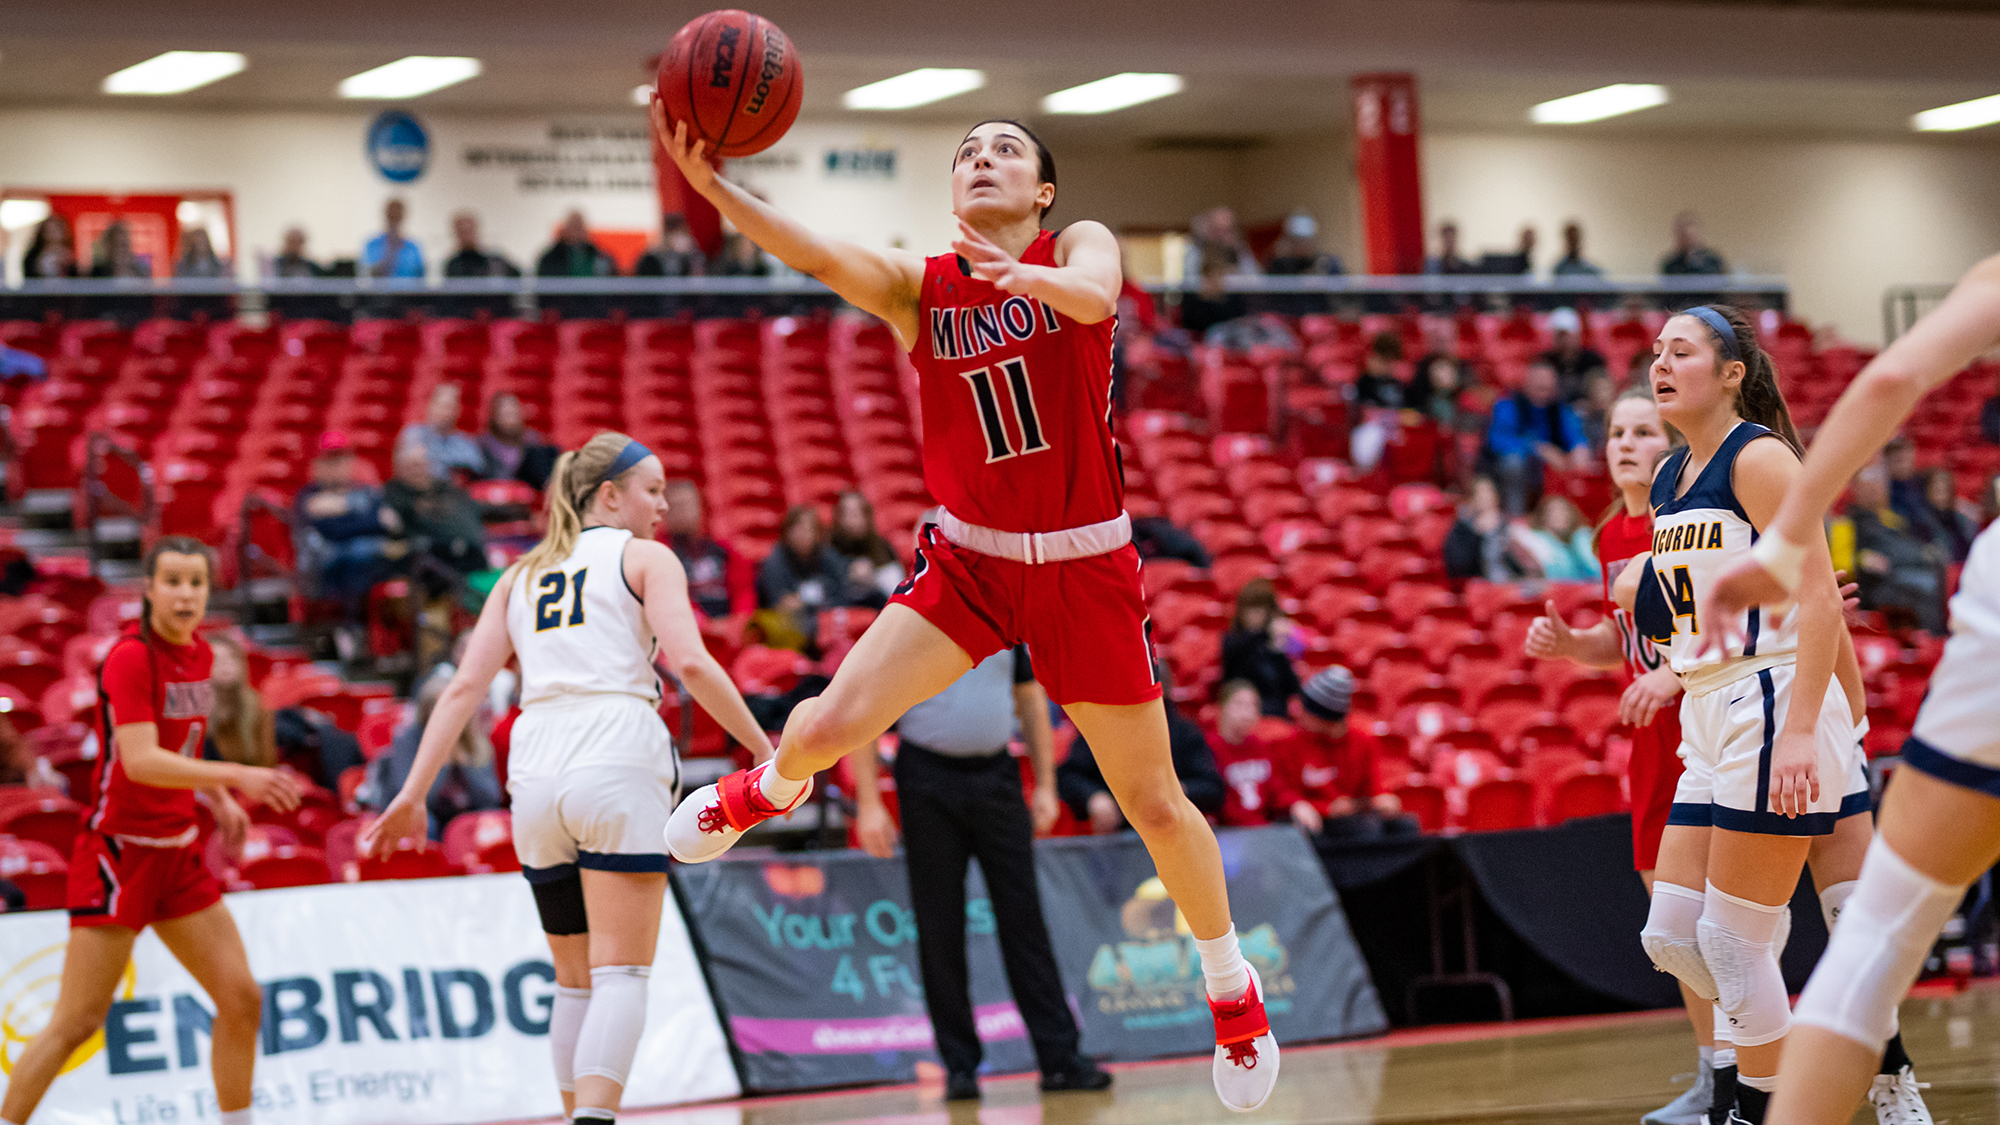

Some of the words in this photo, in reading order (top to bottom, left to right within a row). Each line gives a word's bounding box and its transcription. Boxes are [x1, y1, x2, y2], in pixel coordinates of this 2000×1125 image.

[711, 24, 741, 88] NCAA
[743, 26, 785, 114] Wilson
[959, 355, 1051, 464] 11
[535, 566, 589, 633] 21
[752, 903, 856, 949] Your
[831, 954, 865, 1001] 4
[308, 1068, 436, 1104] Energy
